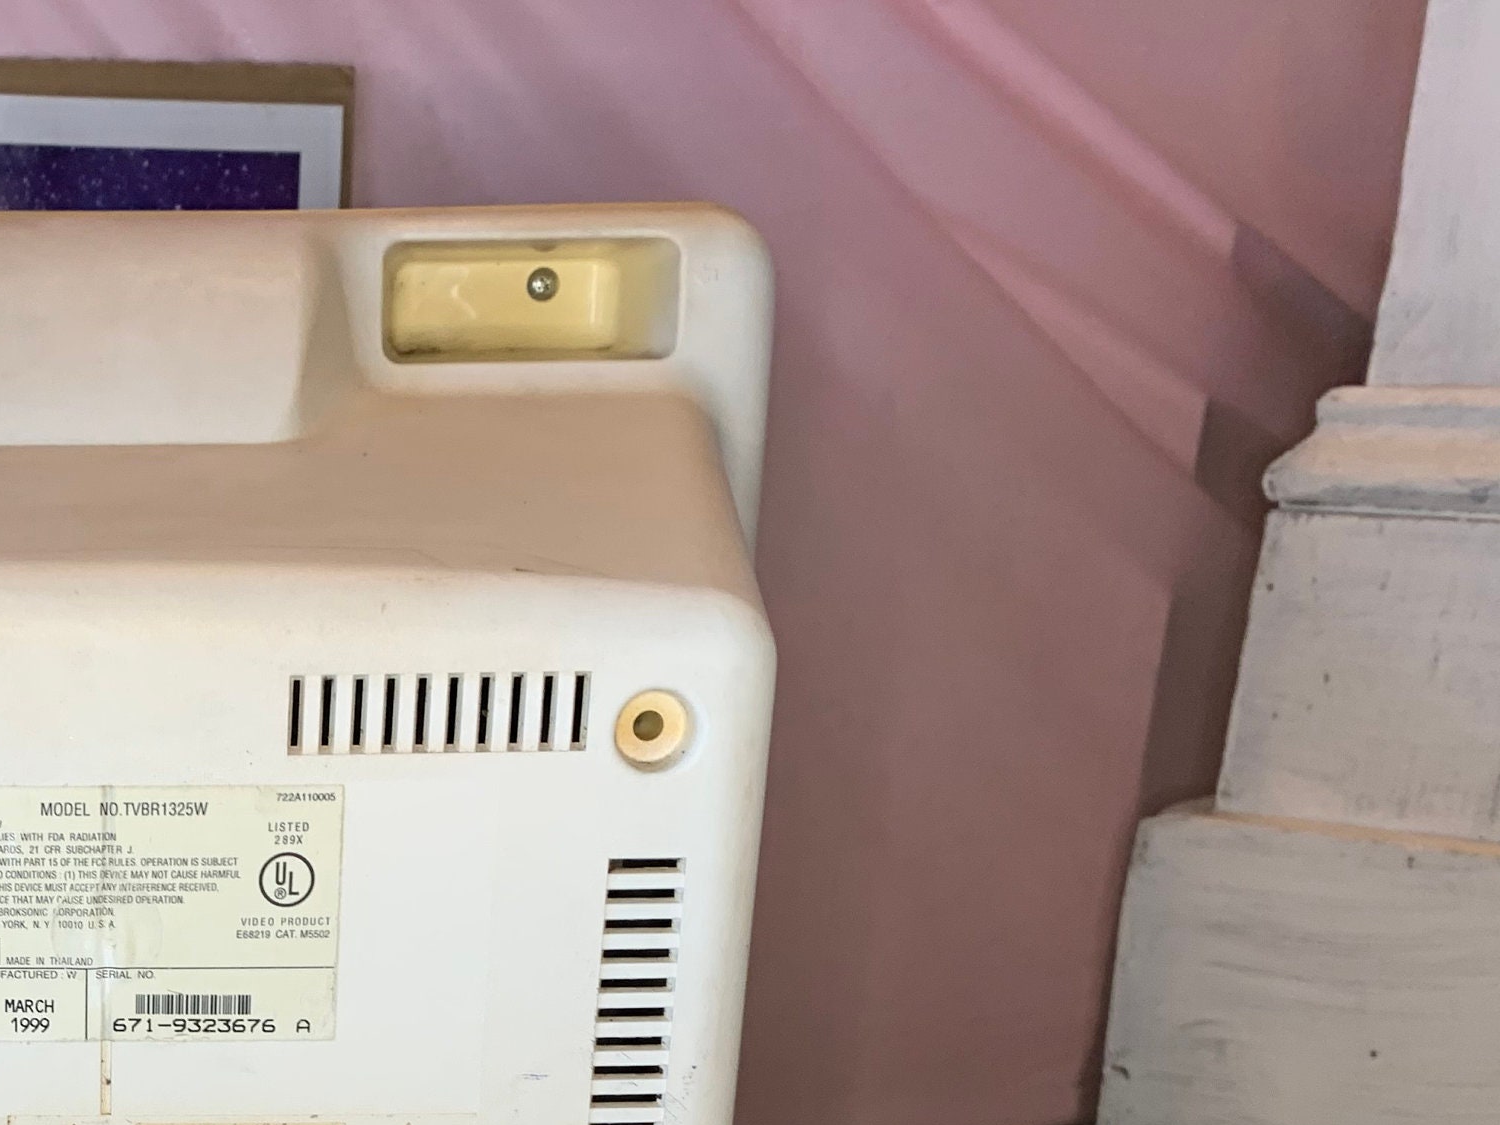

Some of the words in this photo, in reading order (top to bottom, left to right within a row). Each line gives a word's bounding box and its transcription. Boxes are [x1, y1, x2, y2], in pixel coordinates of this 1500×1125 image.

[277, 793, 336, 801] 722A110005
[40, 802, 90, 817] MODEL
[268, 822, 310, 832] LISTED
[20, 832, 43, 841] WITH
[48, 832, 65, 841] FDA
[70, 832, 116, 841] RADIATION
[274, 835, 304, 845] 289X
[29, 845, 39, 854] 21
[44, 845, 60, 854] CFR
[66, 845, 122, 854] SUBCHAPTER
[0, 857, 21, 866] WITH
[24, 857, 45, 866] PART
[49, 857, 58, 866] 15
[60, 857, 71, 866] OF
[73, 857, 89, 866] THE
[140, 857, 188, 866] OPERATION
[191, 857, 199, 866] IS
[201, 857, 238, 866] SUBJECT
[64, 870, 75, 881] (1)
[78, 870, 97, 879] THIS
[100, 870, 127, 879] DEVICE
[130, 870, 149, 879] MAY
[152, 870, 168, 879] NOT
[171, 870, 198, 879] CAUSE
[201, 870, 241, 879] HARMFUL
[14, 883, 42, 892] DEVICE
[45, 883, 67, 892] MUST
[70, 883, 99, 892] ACCEPT
[101, 883, 117, 892] ANY
[119, 883, 176, 892] INTERFERENCE
[12, 895, 33, 904] THAT
[36, 895, 55, 904] MAY
[86, 895, 133, 904] UNDESIRED
[59, 920, 83, 929] 10010
[241, 917, 275, 926] VIDEO
[280, 917, 330, 926] PRODUCT
[236, 930, 271, 939] E68219
[275, 930, 297, 939] CAT.
[300, 930, 330, 939] M5502
[6, 957, 30, 966] MADE
[36, 957, 44, 966] IN
[50, 957, 93, 966] THAILAND
[96, 970, 132, 979] SERIAL
[138, 970, 155, 979] NO.
[5, 999, 55, 1013] MARCH
[11, 1018, 50, 1033] 1999
[113, 1018, 276, 1033] 671-9323676
[296, 1020, 311, 1033] A
